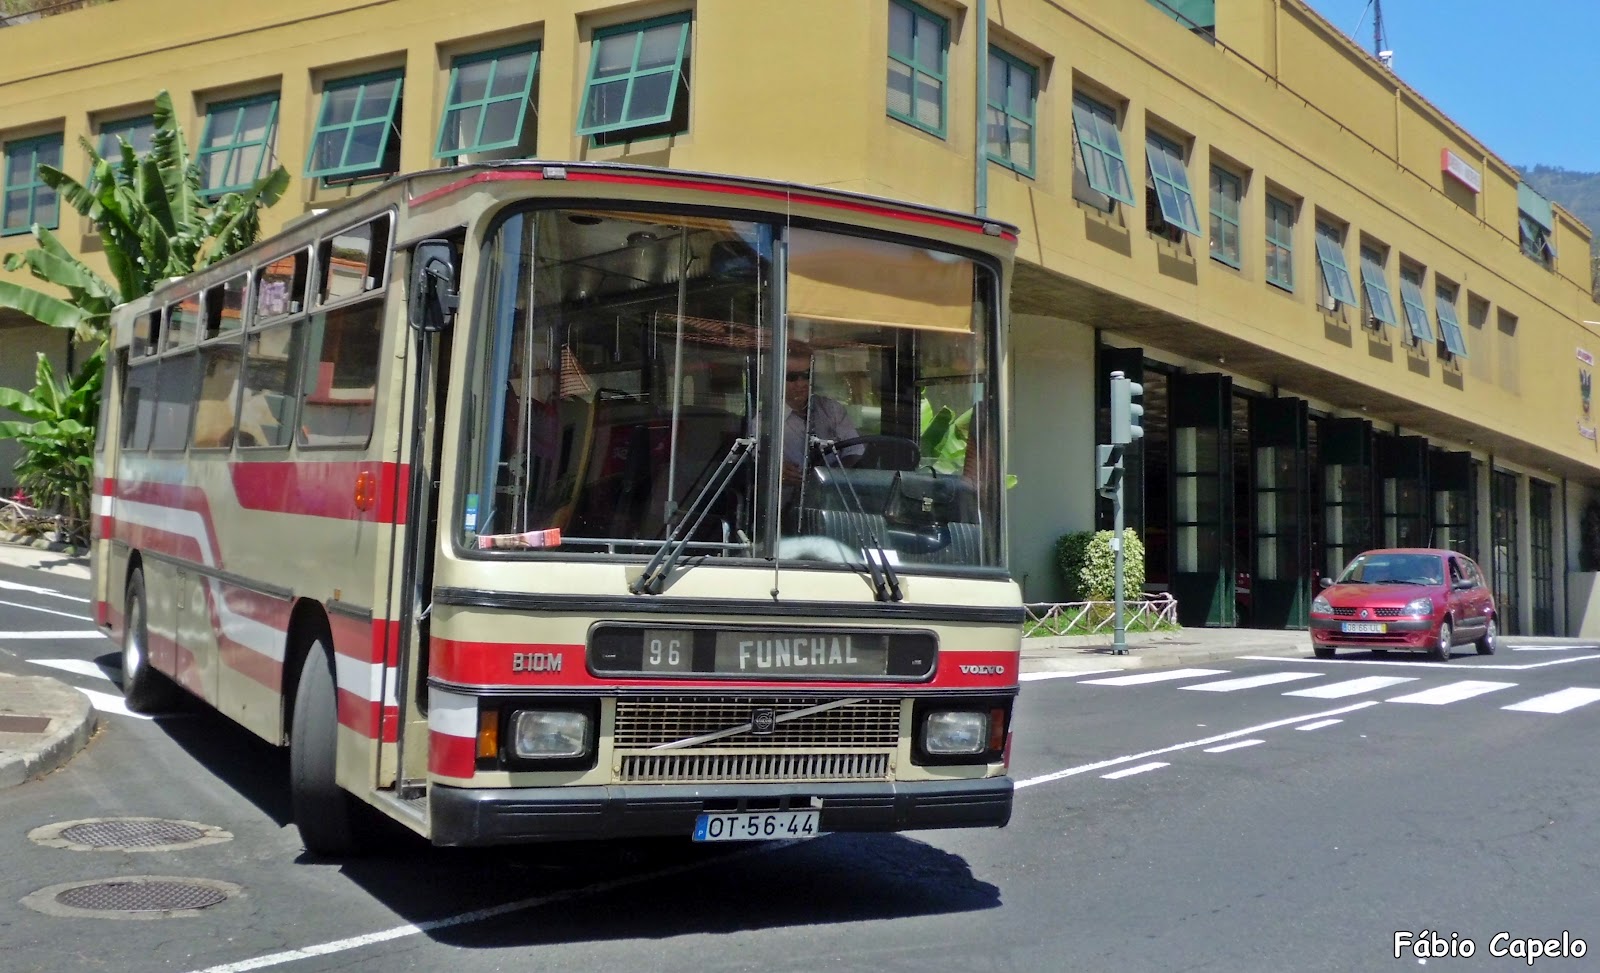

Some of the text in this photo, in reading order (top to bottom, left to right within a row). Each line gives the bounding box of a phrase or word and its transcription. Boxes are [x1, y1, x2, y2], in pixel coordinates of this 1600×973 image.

[649, 635, 858, 671] 96 FUNCHAL
[959, 664, 1005, 675] VOLVO
